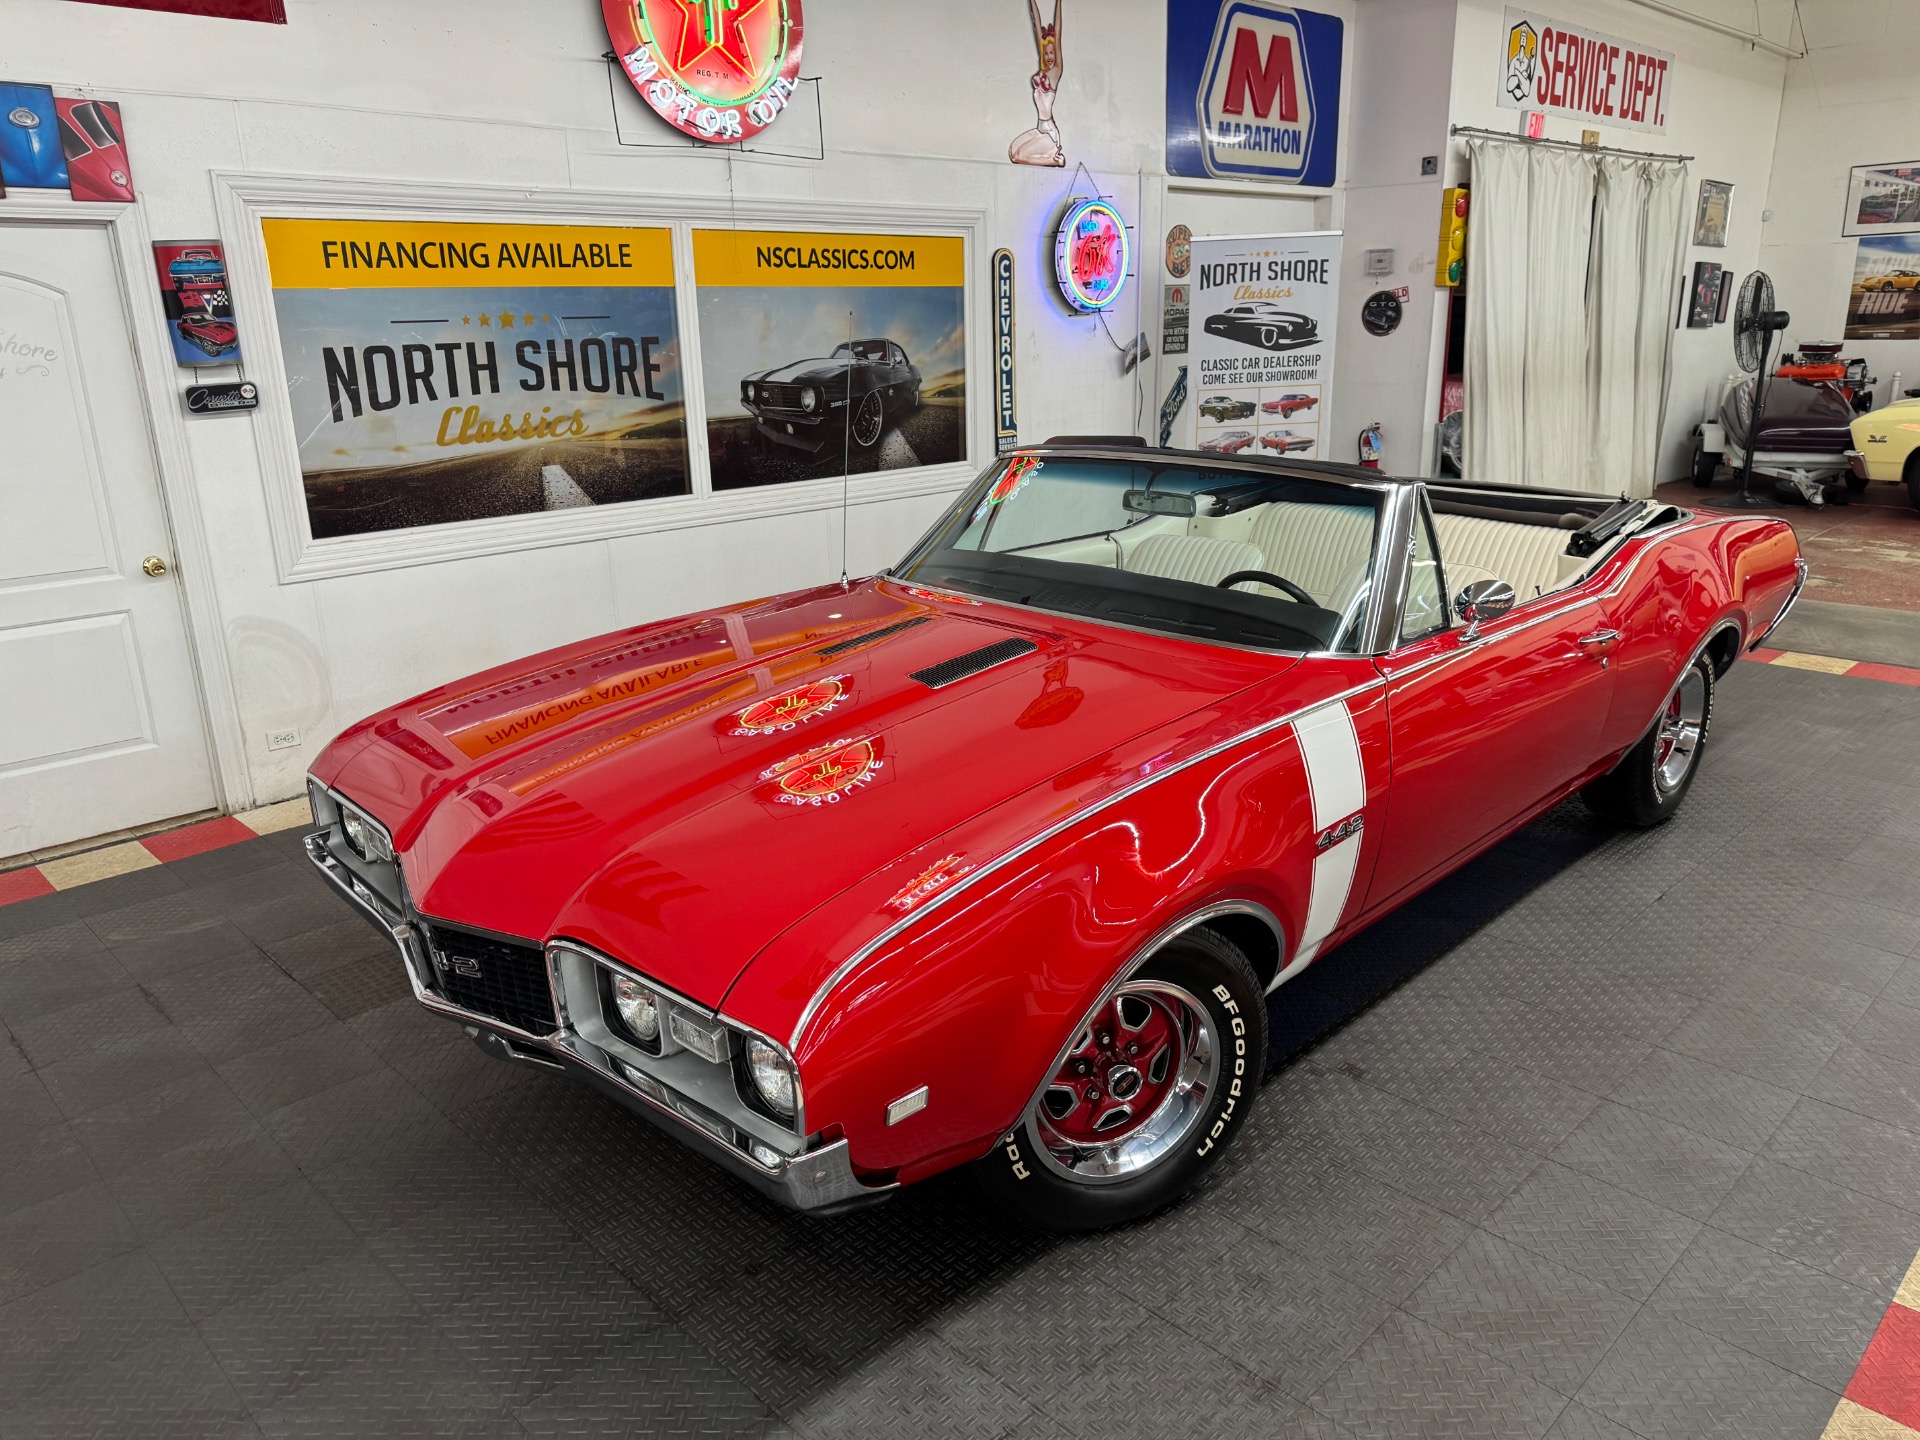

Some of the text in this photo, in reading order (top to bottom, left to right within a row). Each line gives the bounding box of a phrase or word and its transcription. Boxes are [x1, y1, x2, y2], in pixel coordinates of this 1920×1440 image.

[623, 45, 799, 138] MOTOR OIL
[1222, 27, 1299, 123] M
[1536, 26, 1667, 126] SERVICE DEPT.
[1216, 120, 1301, 155] MARATHON
[1528, 113, 1545, 138] EXIT
[322, 240, 632, 269] FINANCING AVAILABLE
[756, 246, 915, 271] NSCLASSICS.COM
[1200, 259, 1329, 290] NORTH SHORE
[1233, 285, 1293, 300] Classics
[1857, 292, 1909, 314] RIDE
[1000, 259, 1012, 427] CHEVROLET
[322, 334, 665, 424] NORTH SHORE
[1201, 354, 1321, 372] CLASSIC CAR DEALERSHIP
[1202, 369, 1317, 385] COME SEE OUR SHOWROOM!
[188, 388, 243, 409] Corvette
[435, 403, 589, 447] Classics
[1315, 814, 1364, 849] 442
[1197, 984, 1246, 1158] BFGoodrich
